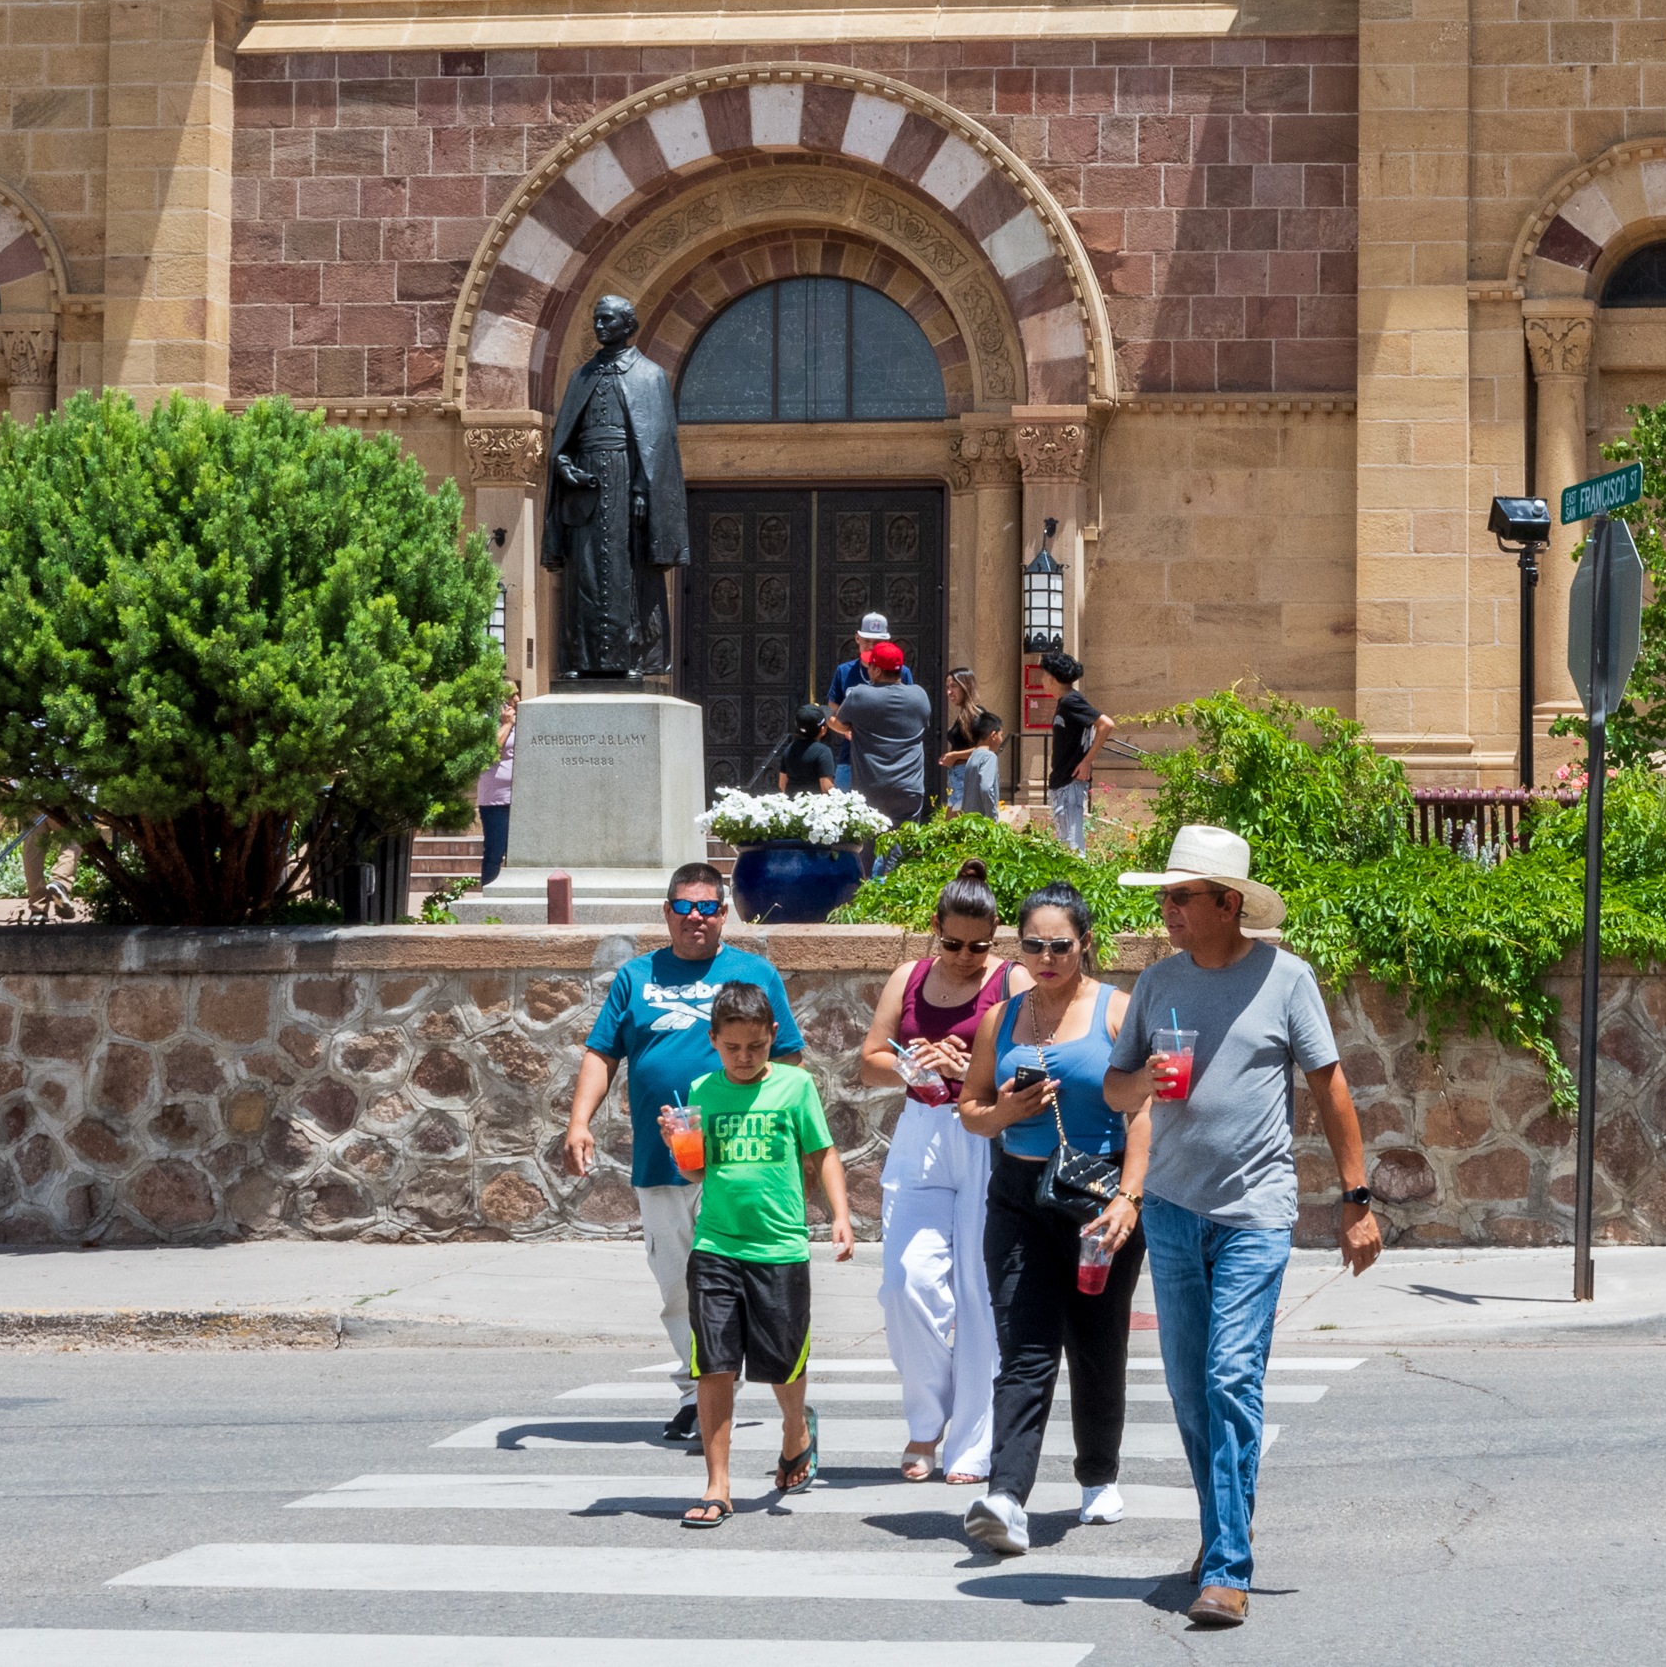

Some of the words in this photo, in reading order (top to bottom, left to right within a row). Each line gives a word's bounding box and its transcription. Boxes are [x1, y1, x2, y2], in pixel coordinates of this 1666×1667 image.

[1565, 490, 1577, 507] EAST
[1579, 474, 1627, 515] FRANCISCO
[1629, 469, 1638, 491] ST
[1565, 505, 1576, 521] SAN
[530, 734, 595, 745] ARCHBISHOP
[643, 980, 723, 1003] Reeb
[715, 1113, 778, 1138] GAME
[719, 1137, 773, 1162] MODE
